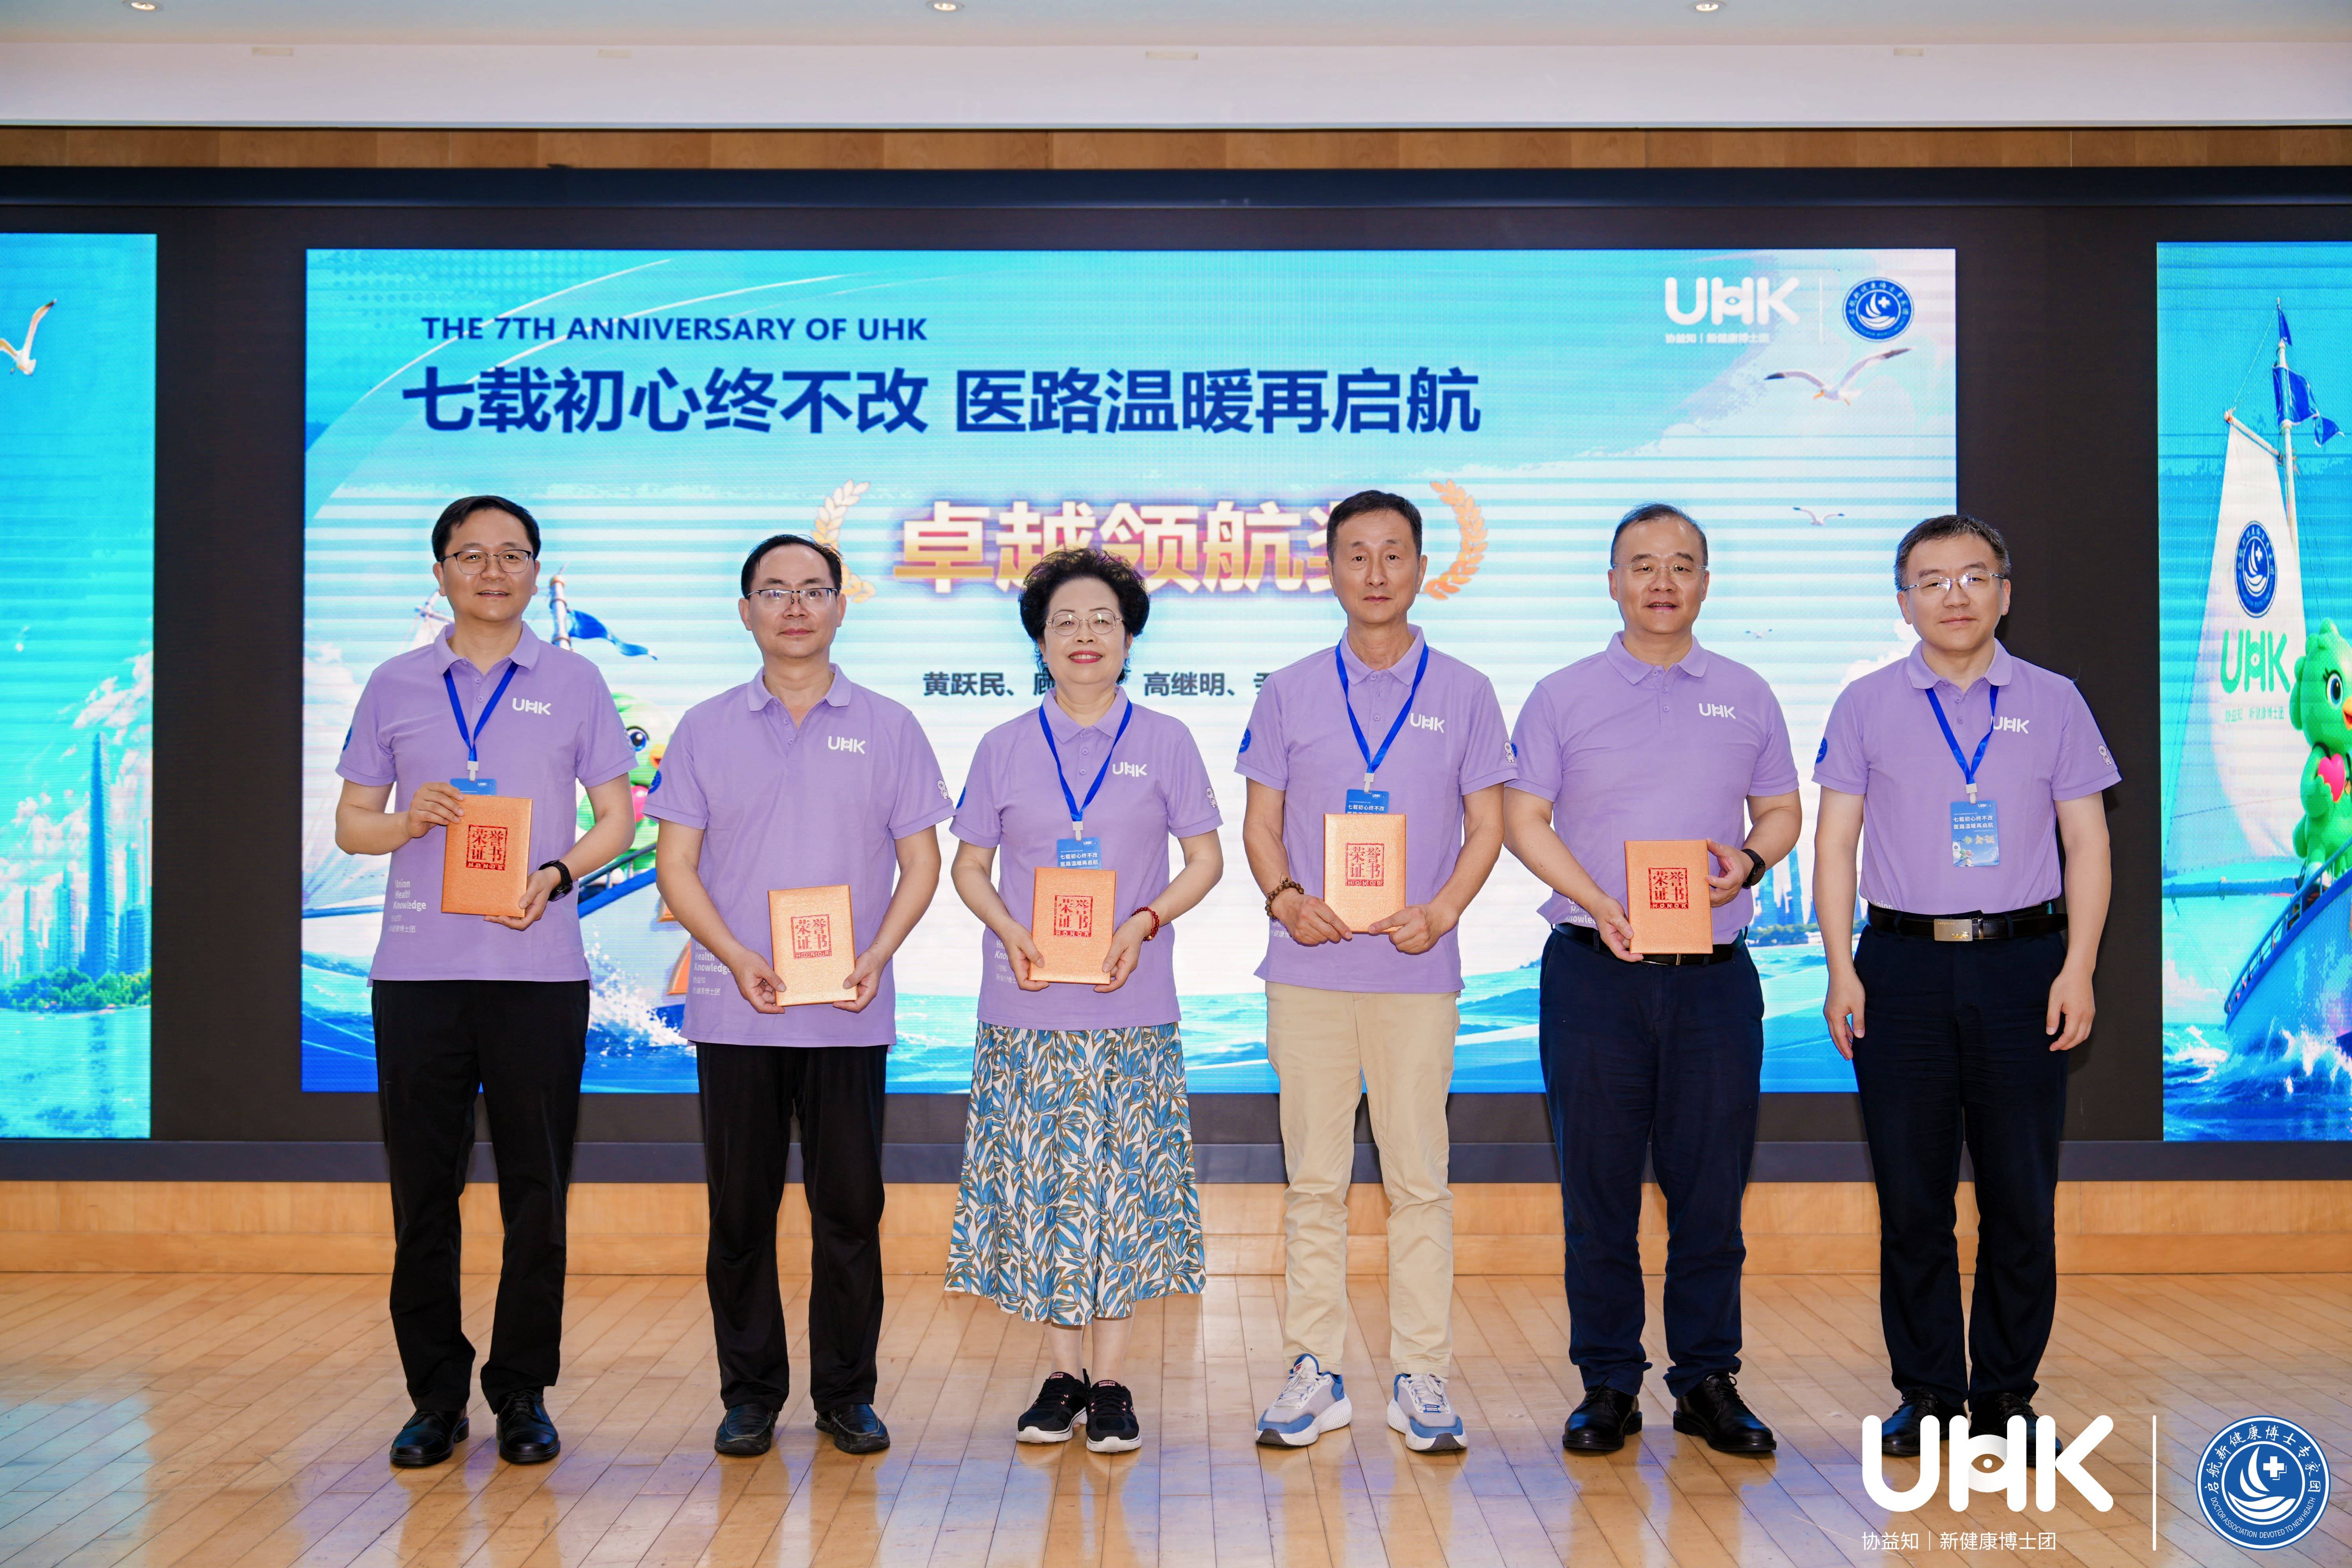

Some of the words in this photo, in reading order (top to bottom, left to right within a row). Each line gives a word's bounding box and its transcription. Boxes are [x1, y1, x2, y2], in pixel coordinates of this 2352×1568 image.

[1665, 277, 1800, 325] UHK
[422, 318, 483, 339] THE
[495, 318, 554, 339] 7TH
[567, 318, 795, 340] ANNIVERSARY
[806, 319, 846, 340] OF
[859, 319, 927, 340] UHK
[403, 367, 928, 433] 七载初心终不改
[957, 367, 1481, 433] 医路温暖再启航
[2220, 629, 2290, 693] UHK
[512, 697, 551, 715] UHK
[1699, 703, 1736, 719] UHK
[1410, 713, 1445, 733] UHK
[1991, 715, 2029, 734] UHK
[828, 736, 866, 754] UHK
[1112, 762, 1147, 777] UHK
[471, 829, 504, 846] 荣誉
[470, 845, 503, 862] 证书
[1349, 847, 1381, 863] 荣誉
[1348, 862, 1380, 878] 证书
[395, 879, 410, 887] Union
[1653, 871, 1684, 886] 荣誉
[1653, 886, 1684, 901] 证书
[393, 900, 426, 911] Knowledge
[1058, 899, 1089, 915] 荣誉
[795, 918, 826, 935] 荣誉
[1059, 914, 1089, 929] 证书
[796, 934, 827, 949] 证书
